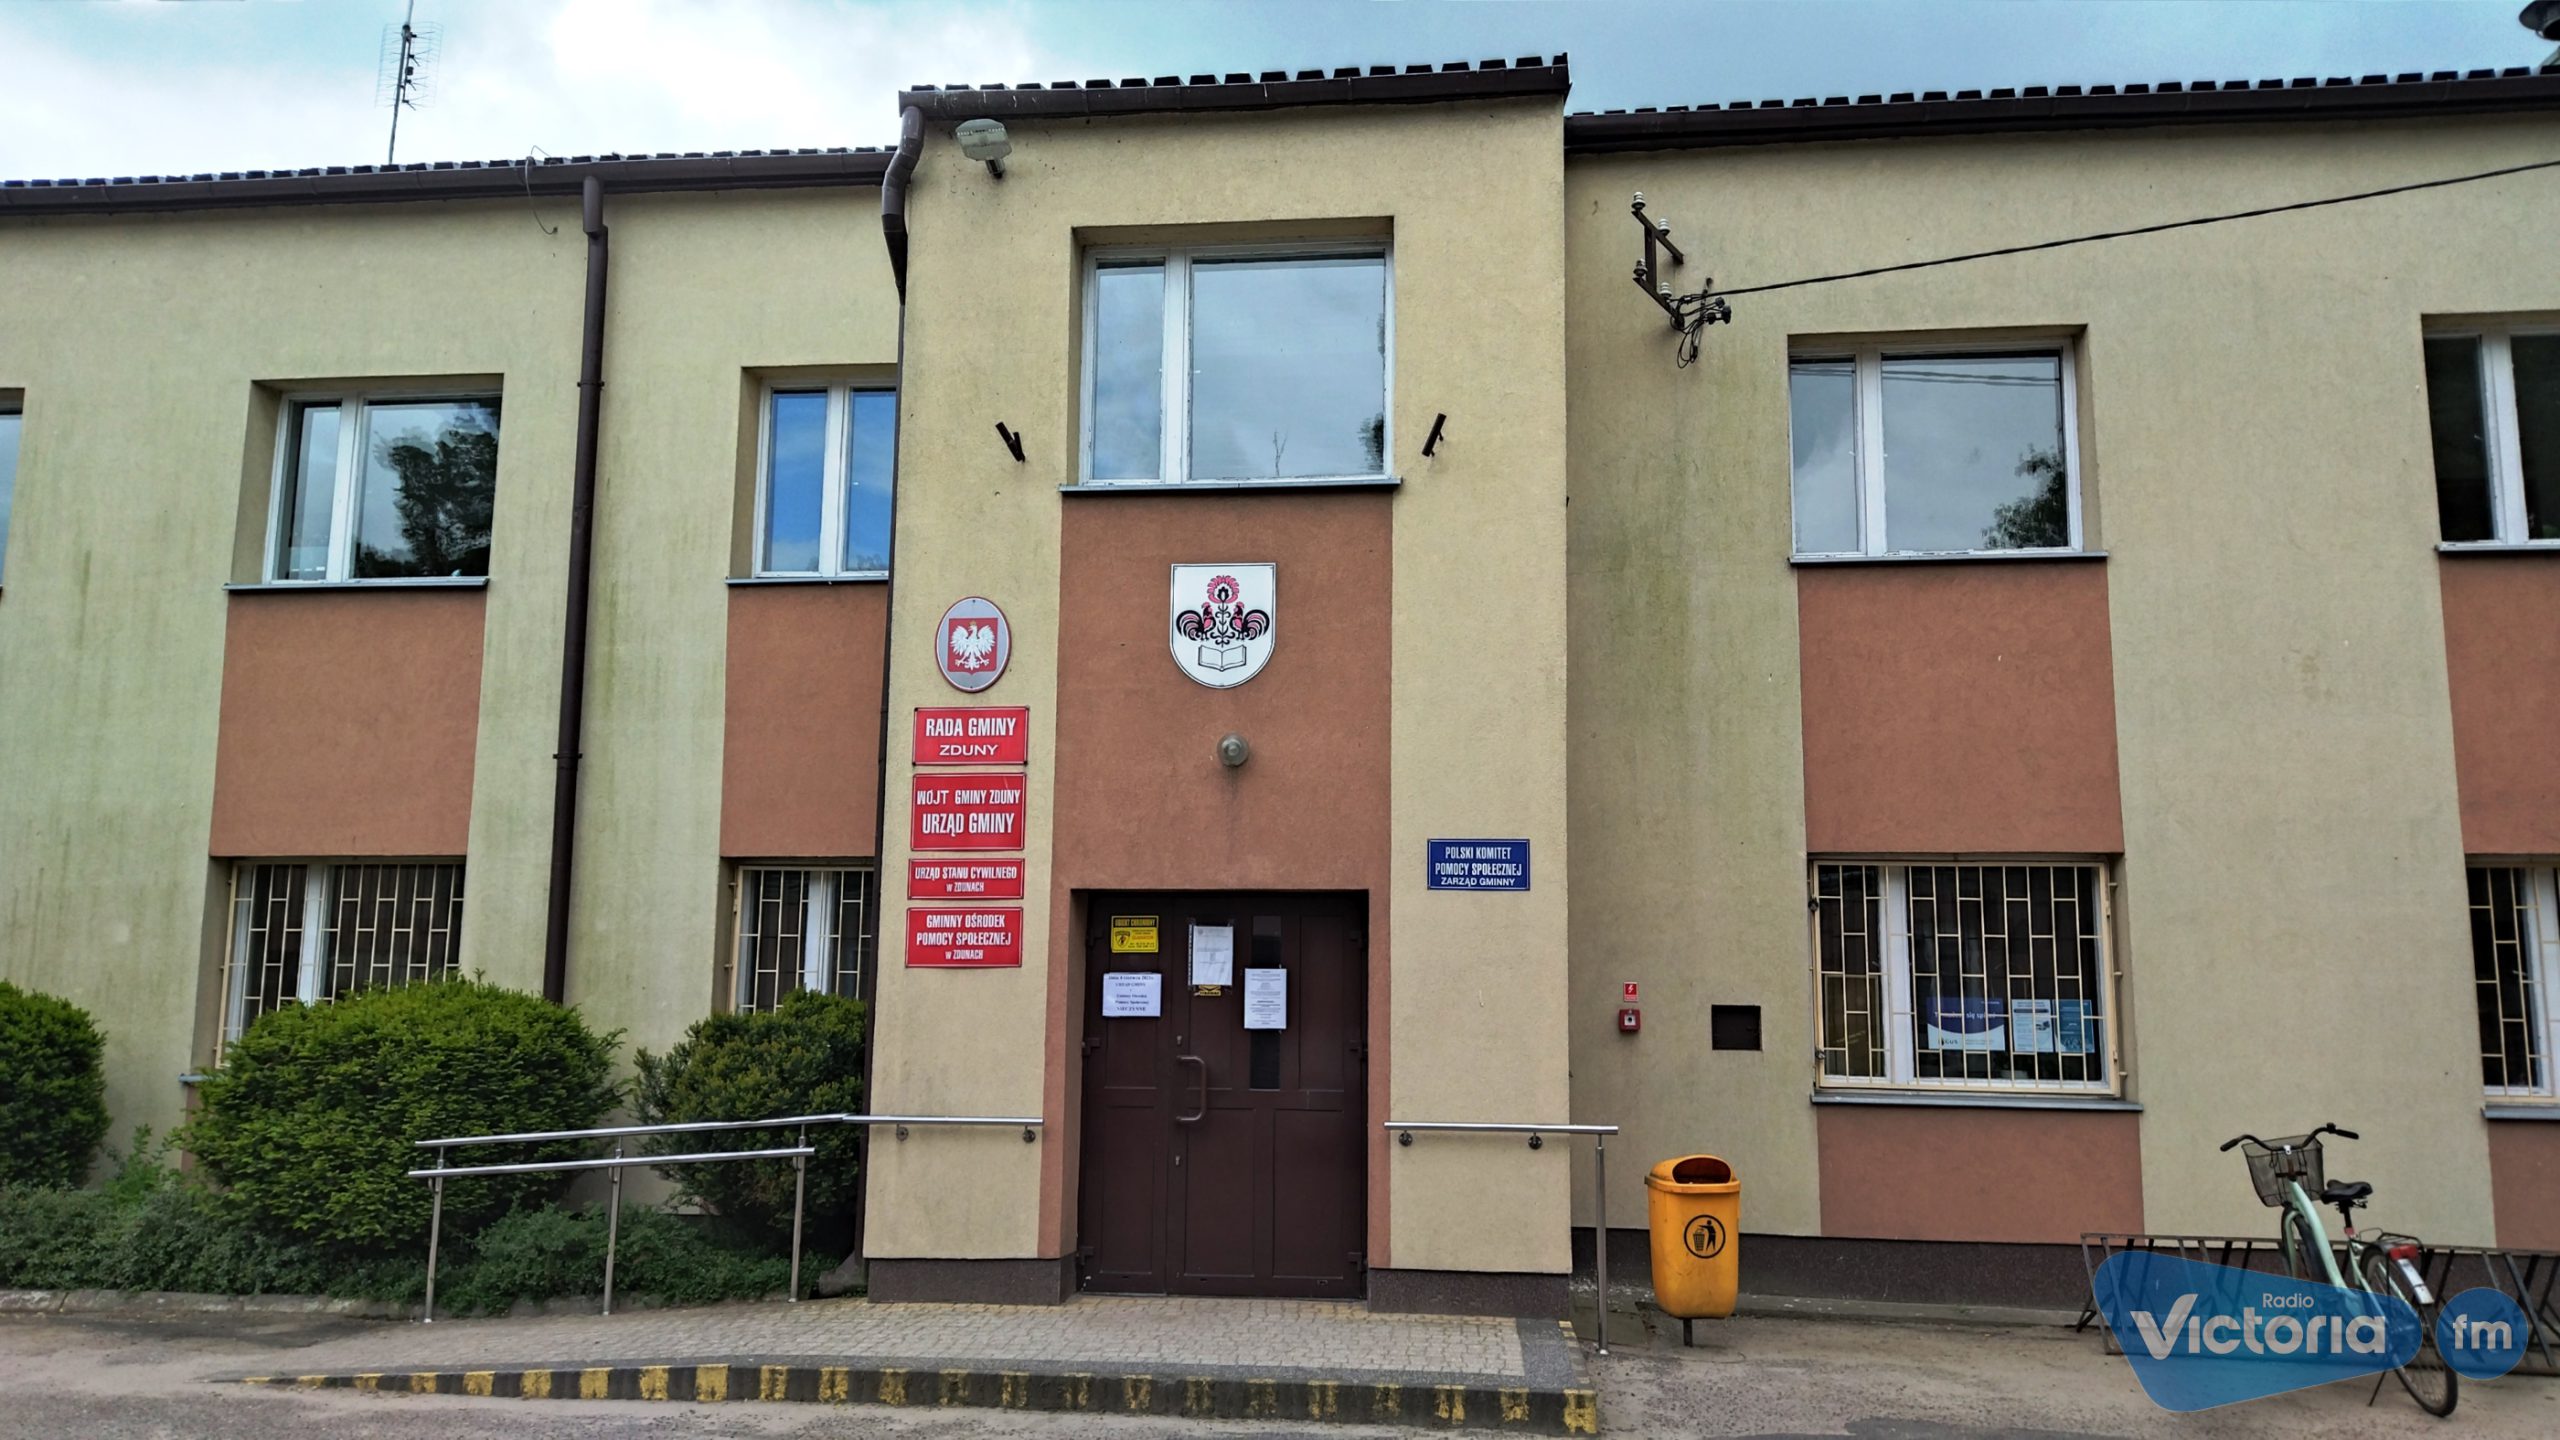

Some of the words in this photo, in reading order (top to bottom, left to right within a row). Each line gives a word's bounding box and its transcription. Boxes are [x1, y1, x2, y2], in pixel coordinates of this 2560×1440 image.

[926, 718, 963, 737] RADA
[968, 717, 1016, 736] GMINY
[939, 744, 998, 756] ZDUNY
[916, 789, 949, 805] WÓJT
[955, 789, 987, 805] GMINY
[989, 789, 1021, 804] ZDUNY
[922, 813, 964, 837] URZĄD
[968, 812, 1015, 834] GMINY
[1445, 846, 1474, 859] POLSKI
[1476, 847, 1512, 859] KOMITET
[915, 867, 940, 881] URZĄD
[942, 867, 968, 879] STANU
[970, 866, 1017, 879] CYWILNEGO
[1435, 862, 1470, 876] POMOCY
[1471, 863, 1522, 876] SPOŁECZNEJ
[954, 882, 984, 892] ZDUNACH
[1441, 877, 1477, 887] ZARZĄD
[1479, 878, 1515, 887] GMINNY
[926, 915, 963, 928] GMINNY
[965, 912, 1005, 928] OŚRODEK
[916, 932, 954, 946] POMOCY
[956, 932, 1011, 946] SPOŁECZNEJ
[953, 949, 984, 960] ZDUNACH
